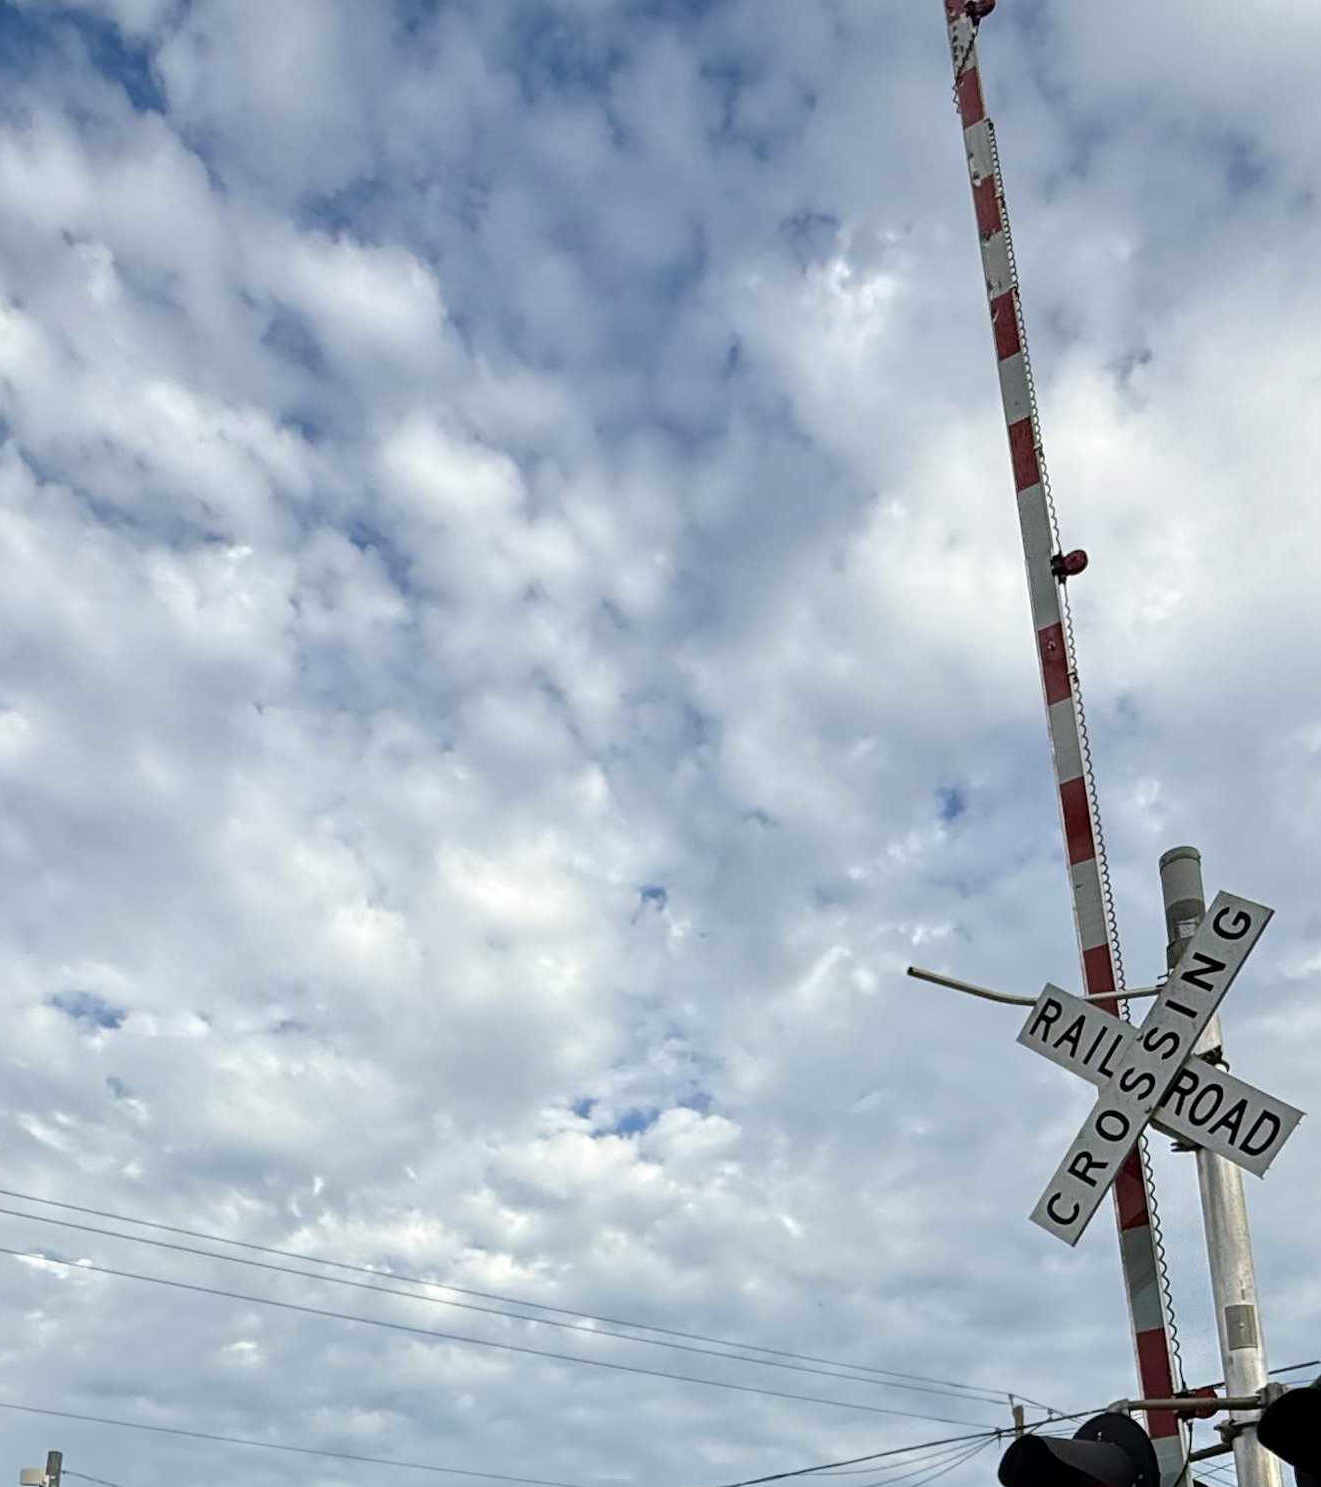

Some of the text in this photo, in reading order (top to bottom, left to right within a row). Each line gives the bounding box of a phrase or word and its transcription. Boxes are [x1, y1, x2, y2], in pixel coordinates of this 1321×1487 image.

[1029, 997, 1281, 1156] RAIL ROAD
[1046, 906, 1251, 1226] CROSSING
